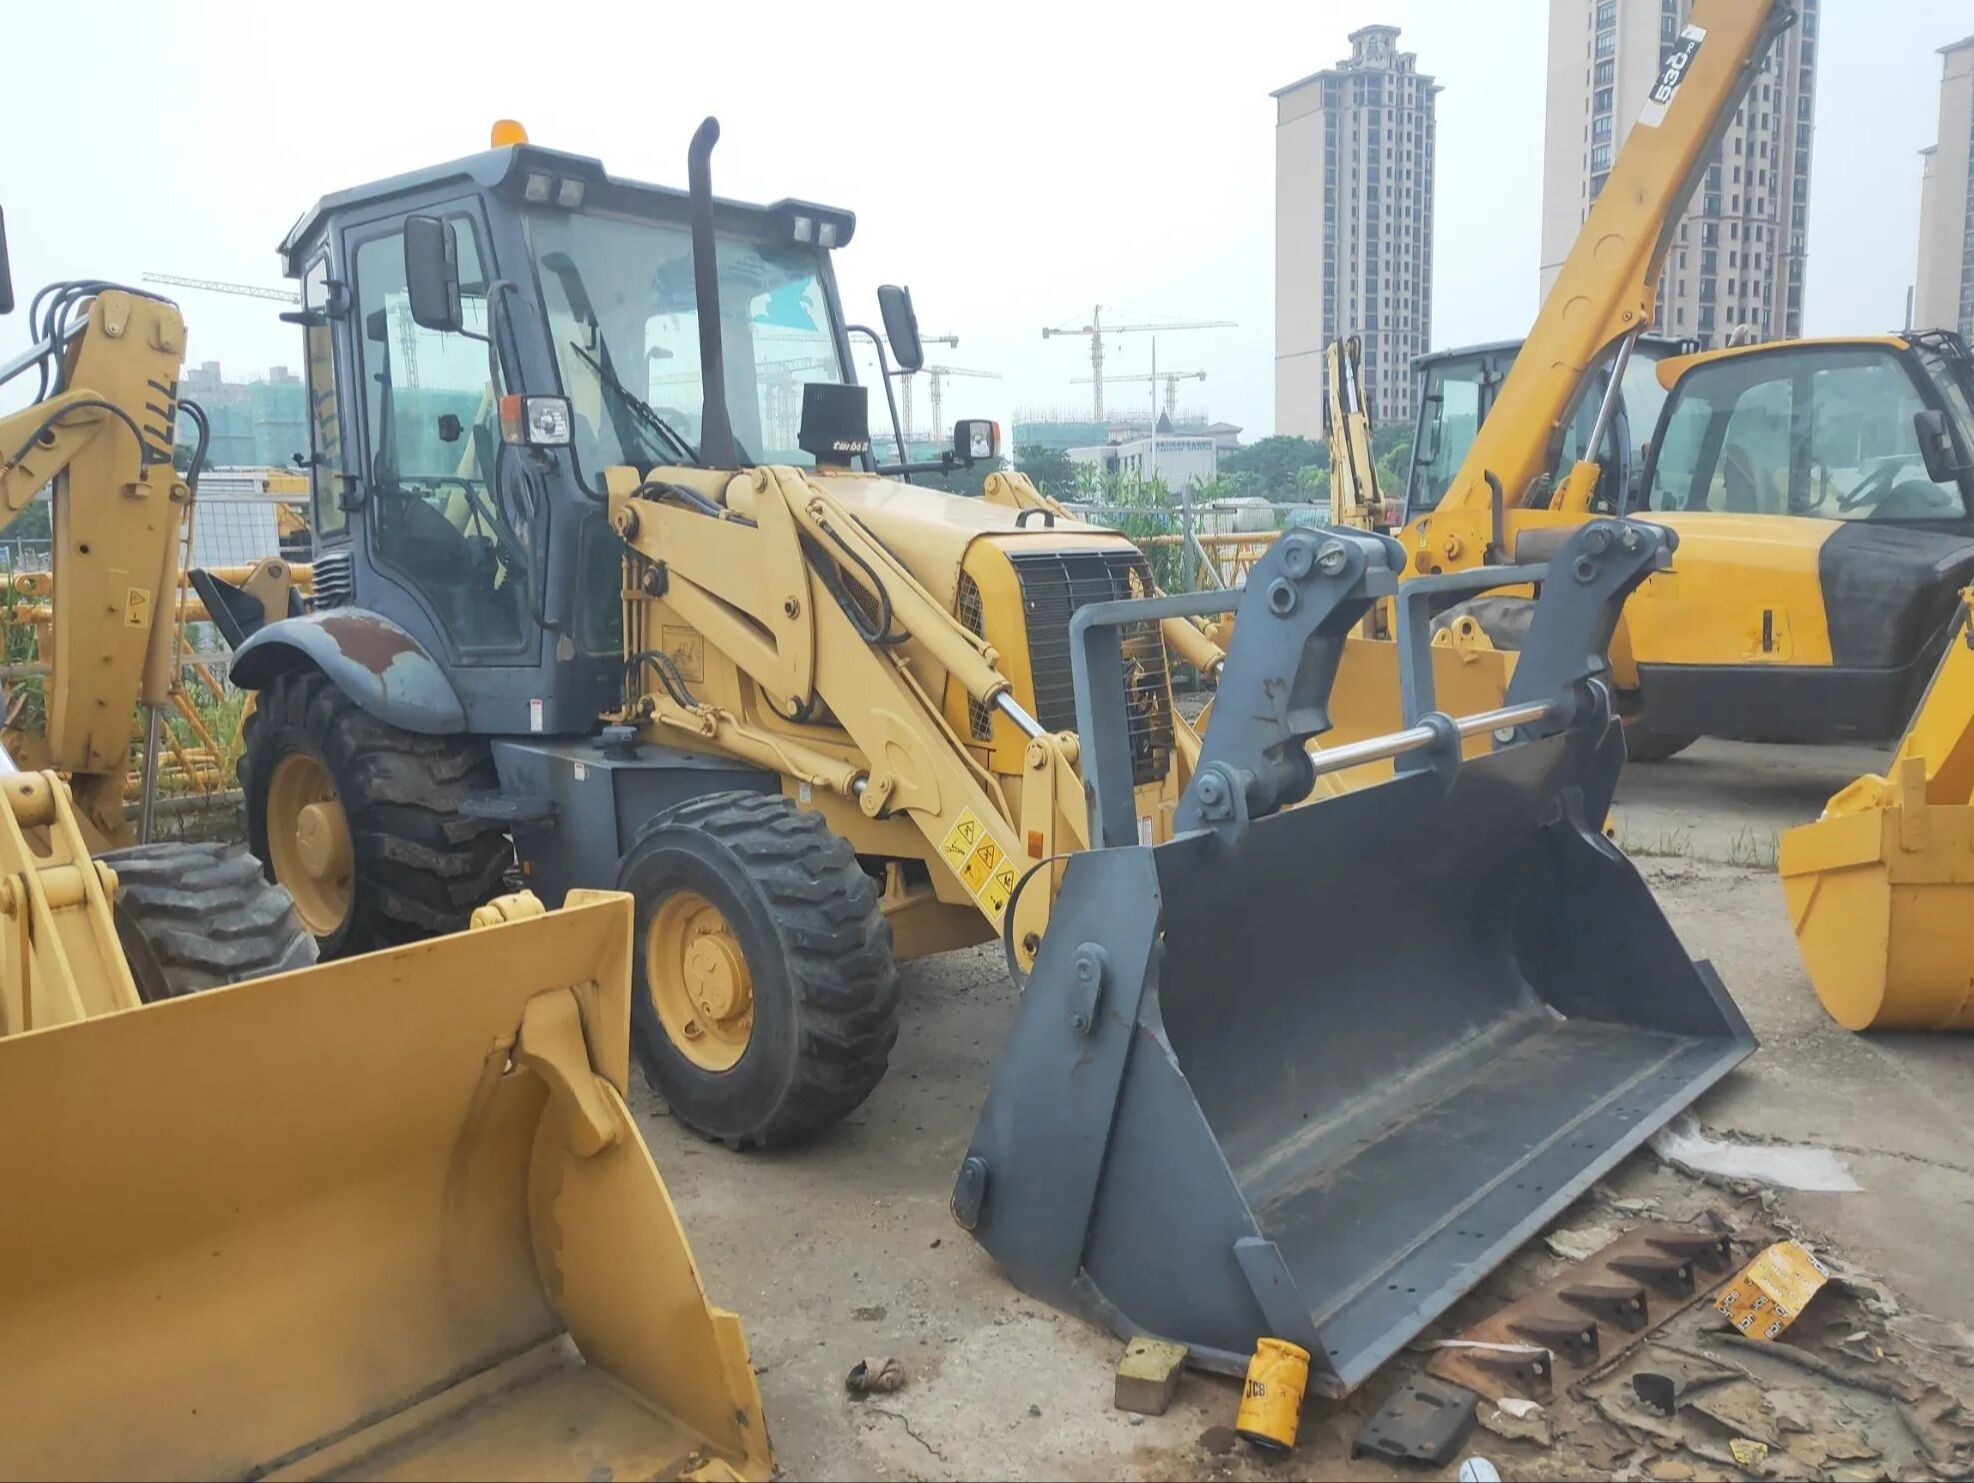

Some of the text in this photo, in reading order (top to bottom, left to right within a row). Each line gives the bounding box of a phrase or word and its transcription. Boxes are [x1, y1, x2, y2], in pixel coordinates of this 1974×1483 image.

[1655, 52, 1688, 101] 530
[142, 379, 177, 465] 777A
[833, 440, 861, 451] turbo
[1723, 1290, 1740, 1308] JCB
[1752, 1295, 1769, 1311] JCB
[1765, 1320, 1782, 1338] JCB
[1247, 1379, 1265, 1399] JCB
